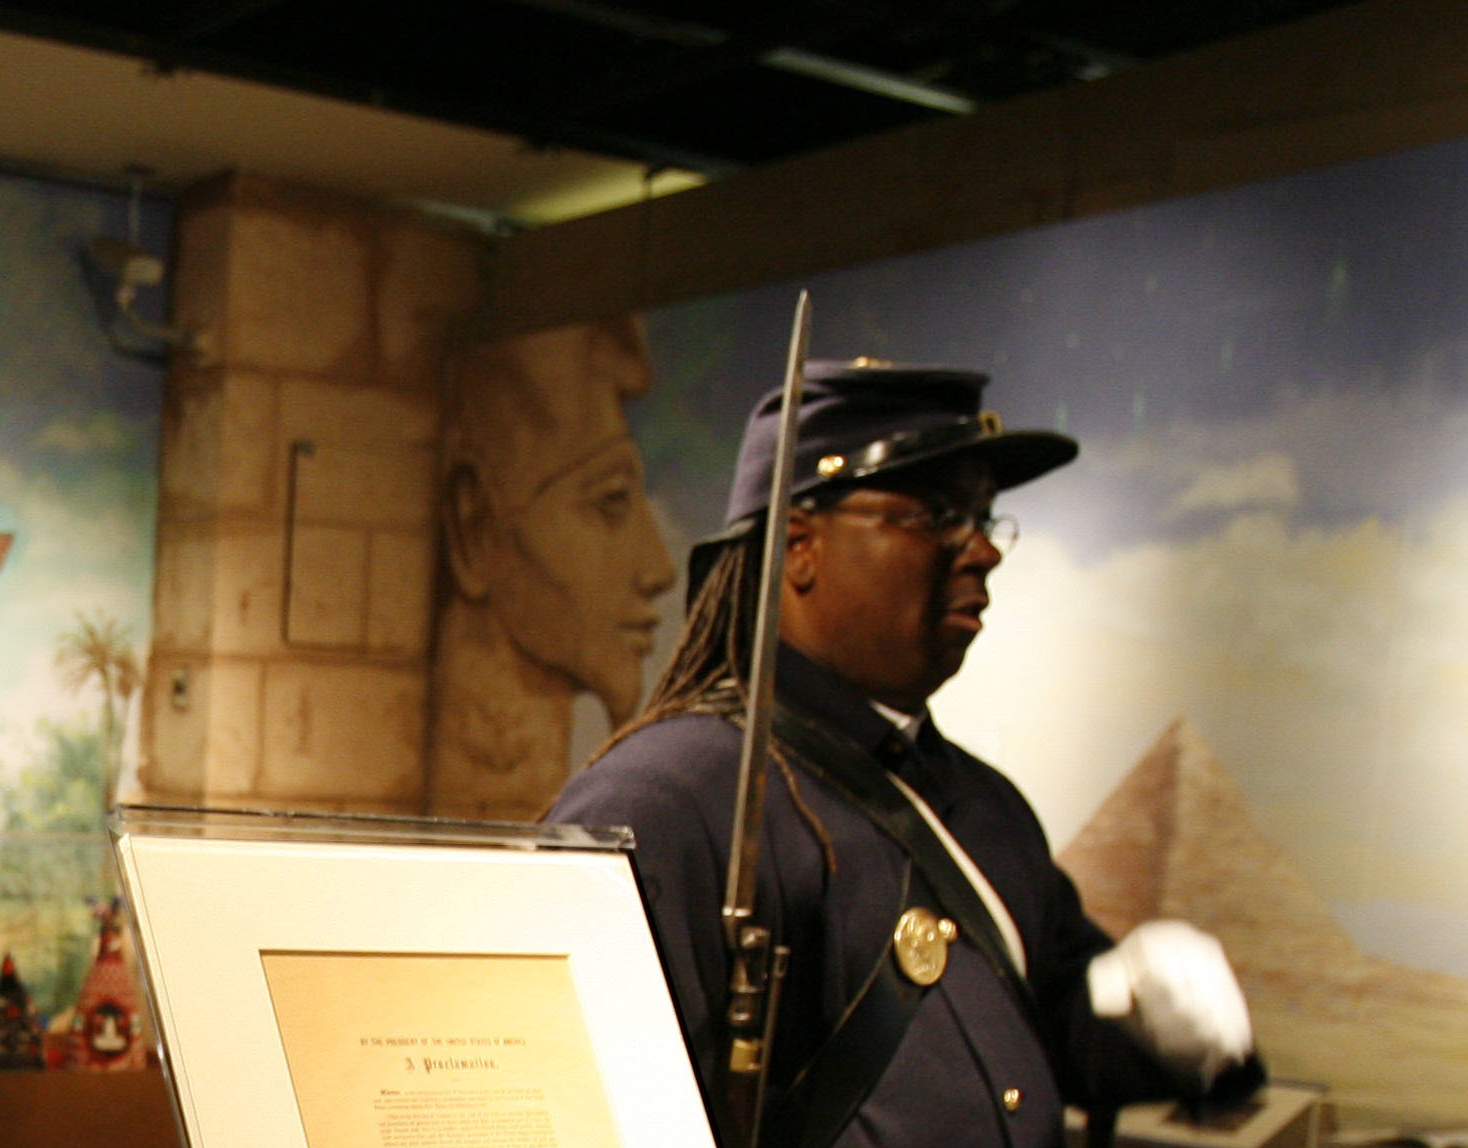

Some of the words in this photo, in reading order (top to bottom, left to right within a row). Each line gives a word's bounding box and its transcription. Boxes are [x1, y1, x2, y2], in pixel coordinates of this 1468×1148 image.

[371, 1037, 383, 1046] THE
[386, 1037, 418, 1047] PRESIDENT
[404, 1056, 416, 1071] A
